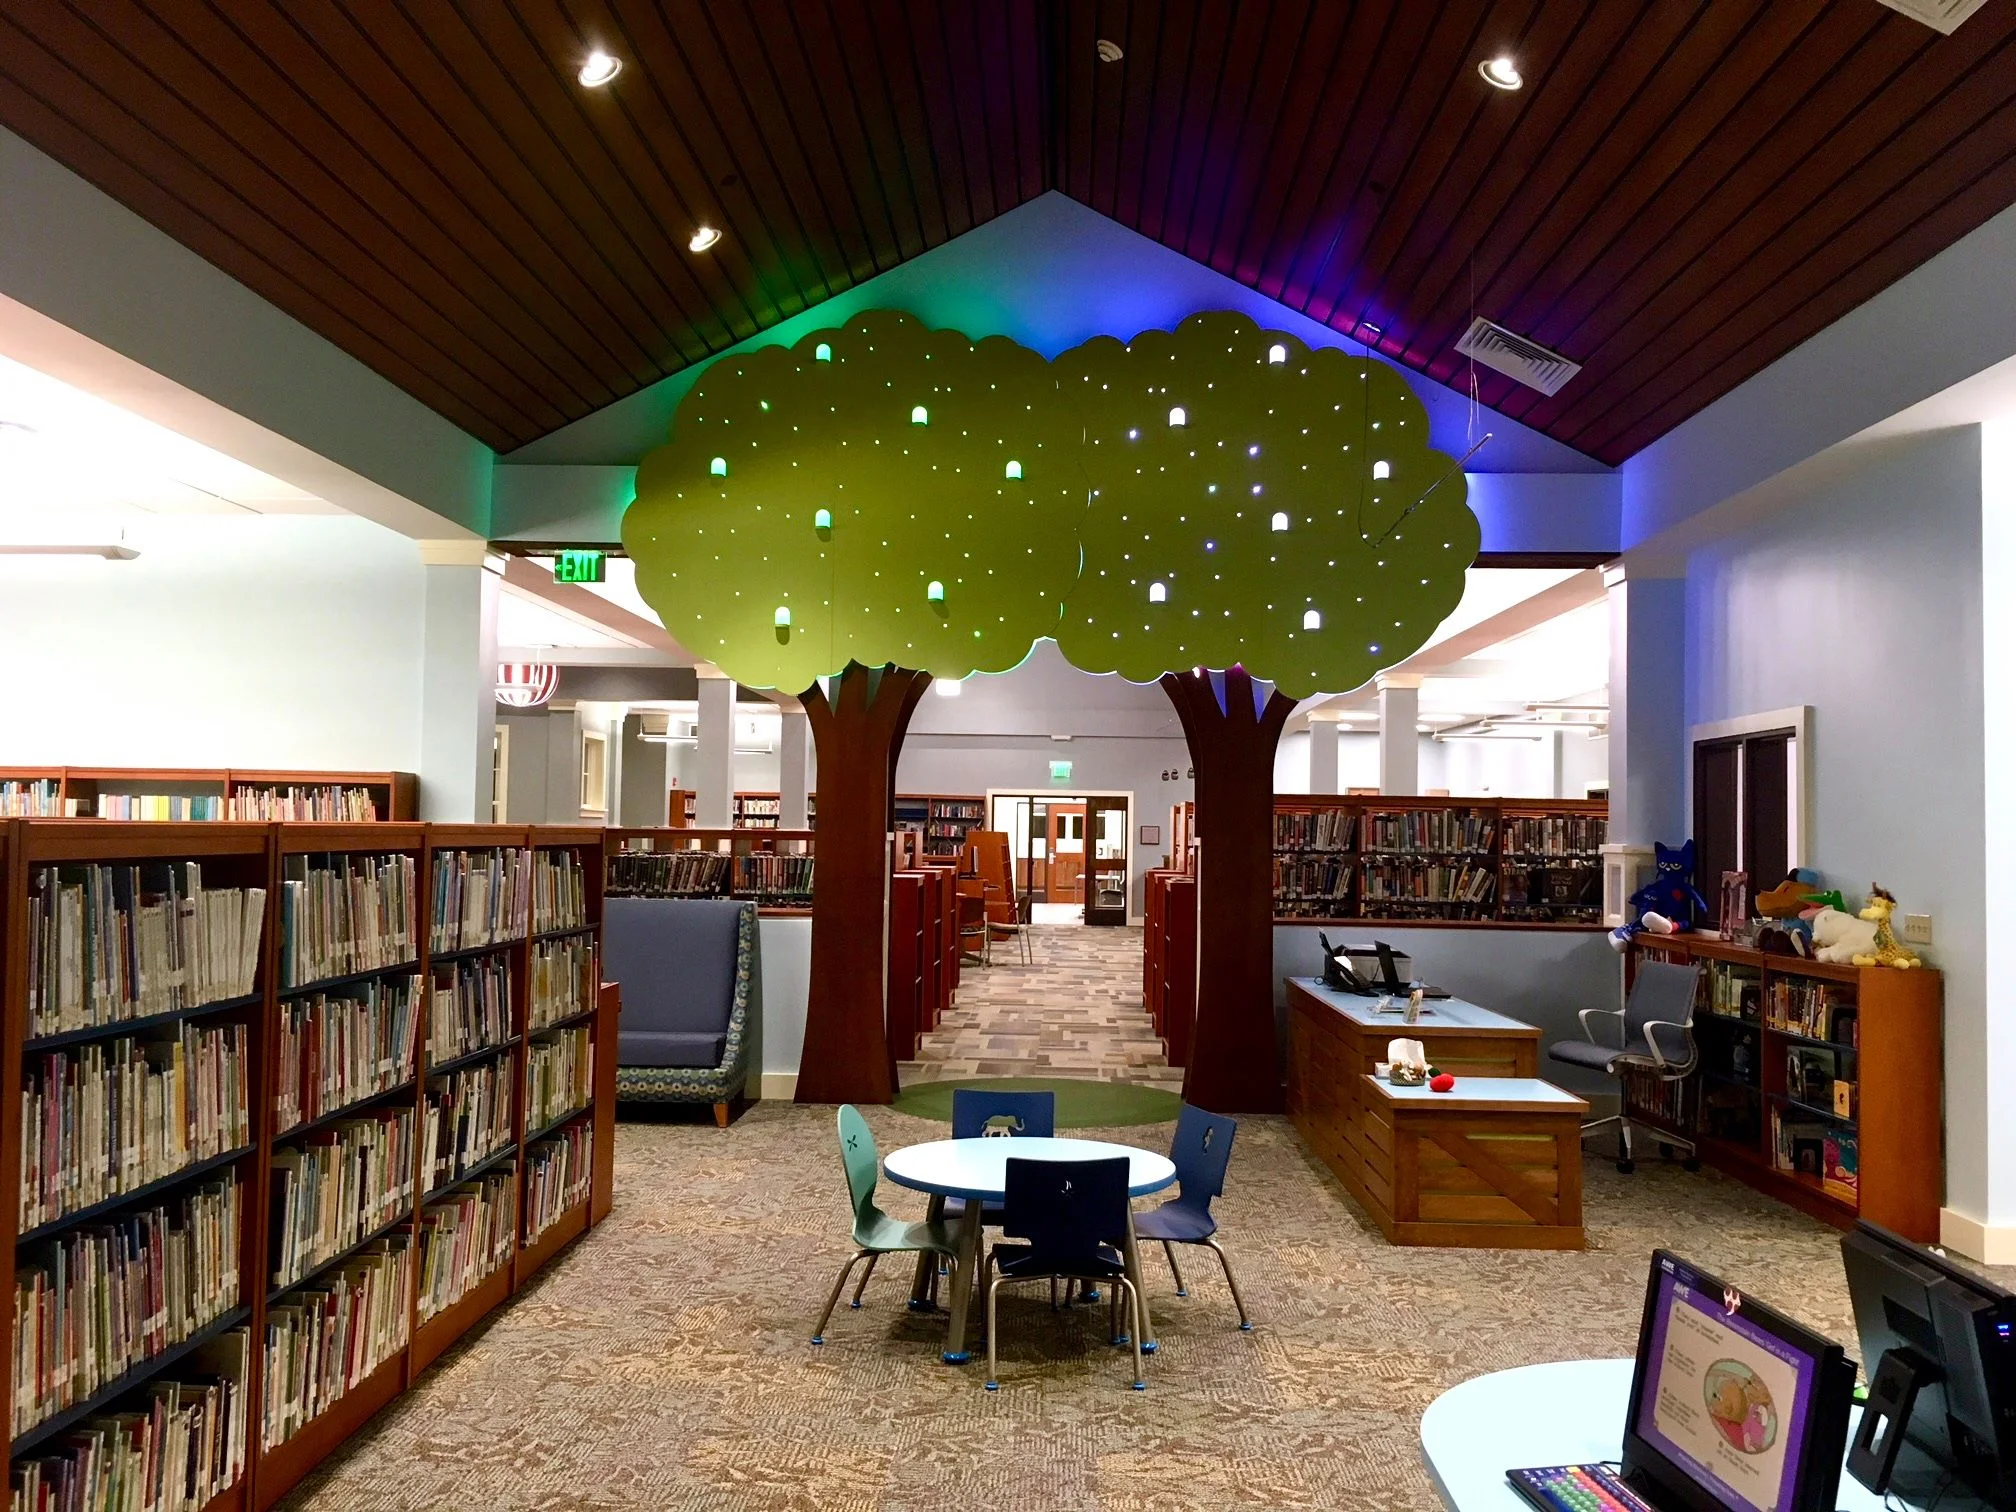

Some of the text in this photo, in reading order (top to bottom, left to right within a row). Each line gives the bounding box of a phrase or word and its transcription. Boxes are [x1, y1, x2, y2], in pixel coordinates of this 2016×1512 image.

[561, 553, 599, 581] EXIT
[1661, 1258, 1675, 1271] AWE
[1672, 1281, 1690, 1298] AWE
